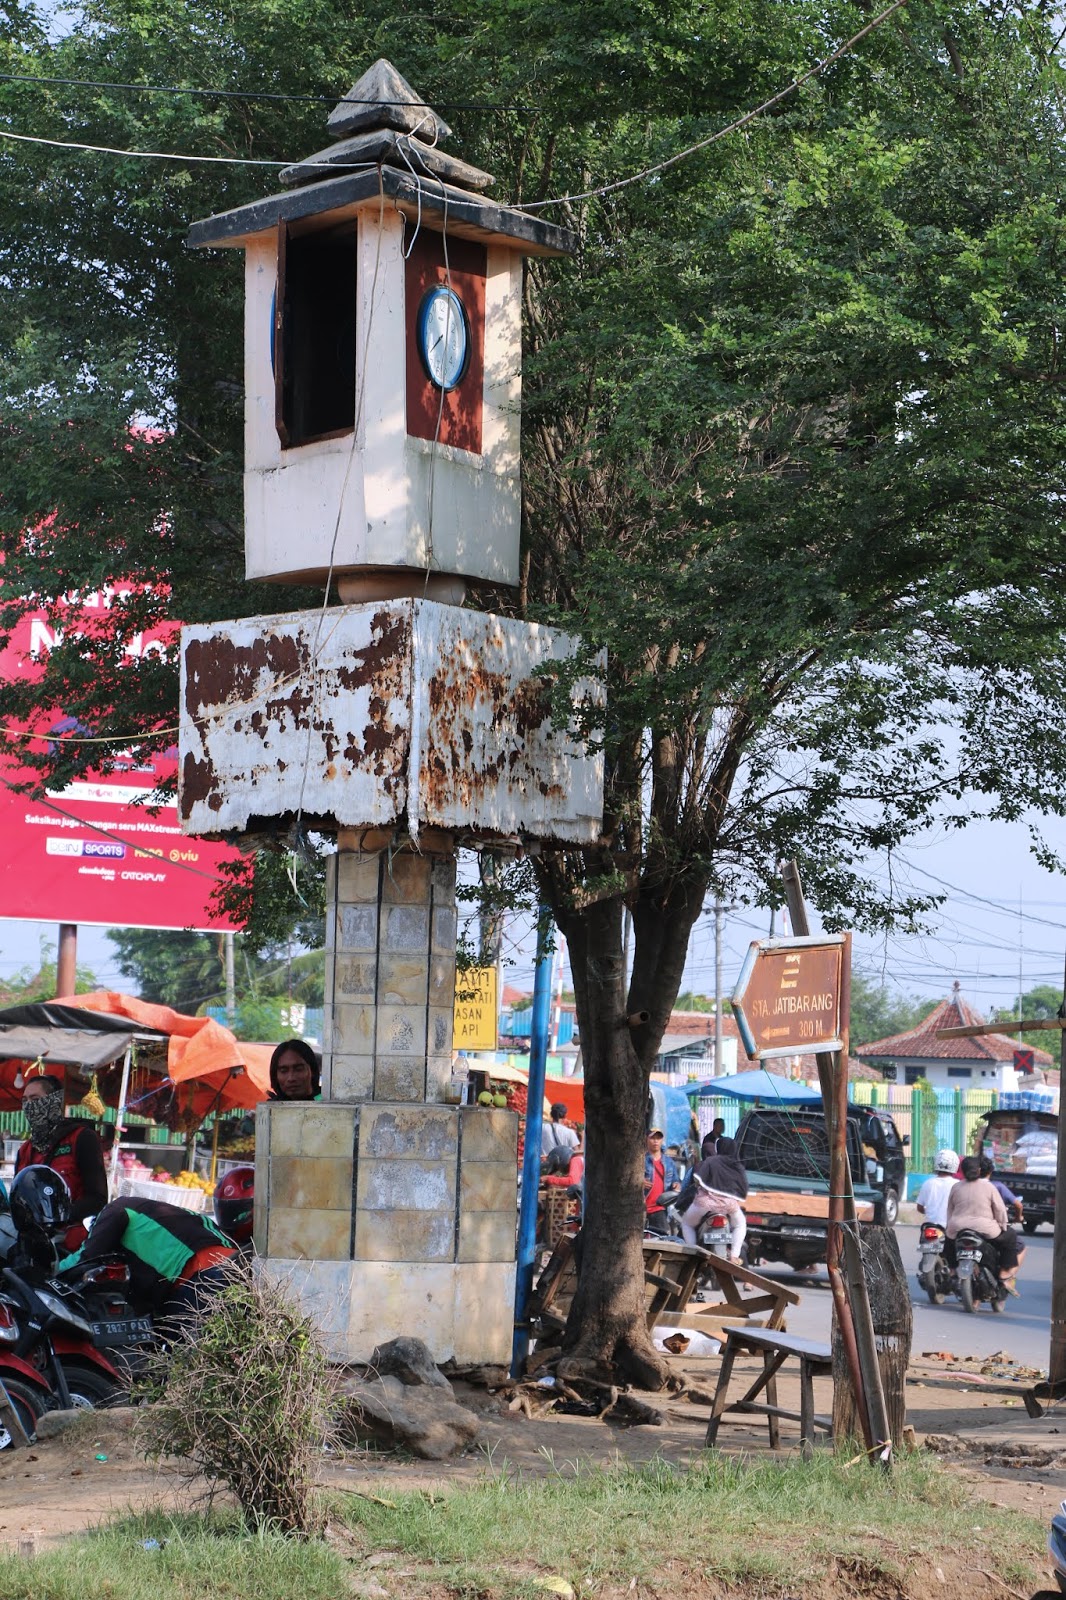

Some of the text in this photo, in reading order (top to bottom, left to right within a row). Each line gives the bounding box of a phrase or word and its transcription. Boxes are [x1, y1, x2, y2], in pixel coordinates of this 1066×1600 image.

[25, 814, 61, 825] Saksikan
[118, 823, 136, 831] seru
[85, 843, 122, 857] SPORTS
[181, 849, 199, 861] viu
[120, 871, 166, 882] CATCHPLAY
[752, 994, 833, 1018] STA. JATIBARANG
[461, 1024, 479, 1036] API
[799, 1019, 823, 1037] 300 M
[1002, 1181, 1055, 1191] UZUKI
[93, 1325, 101, 1335] E
